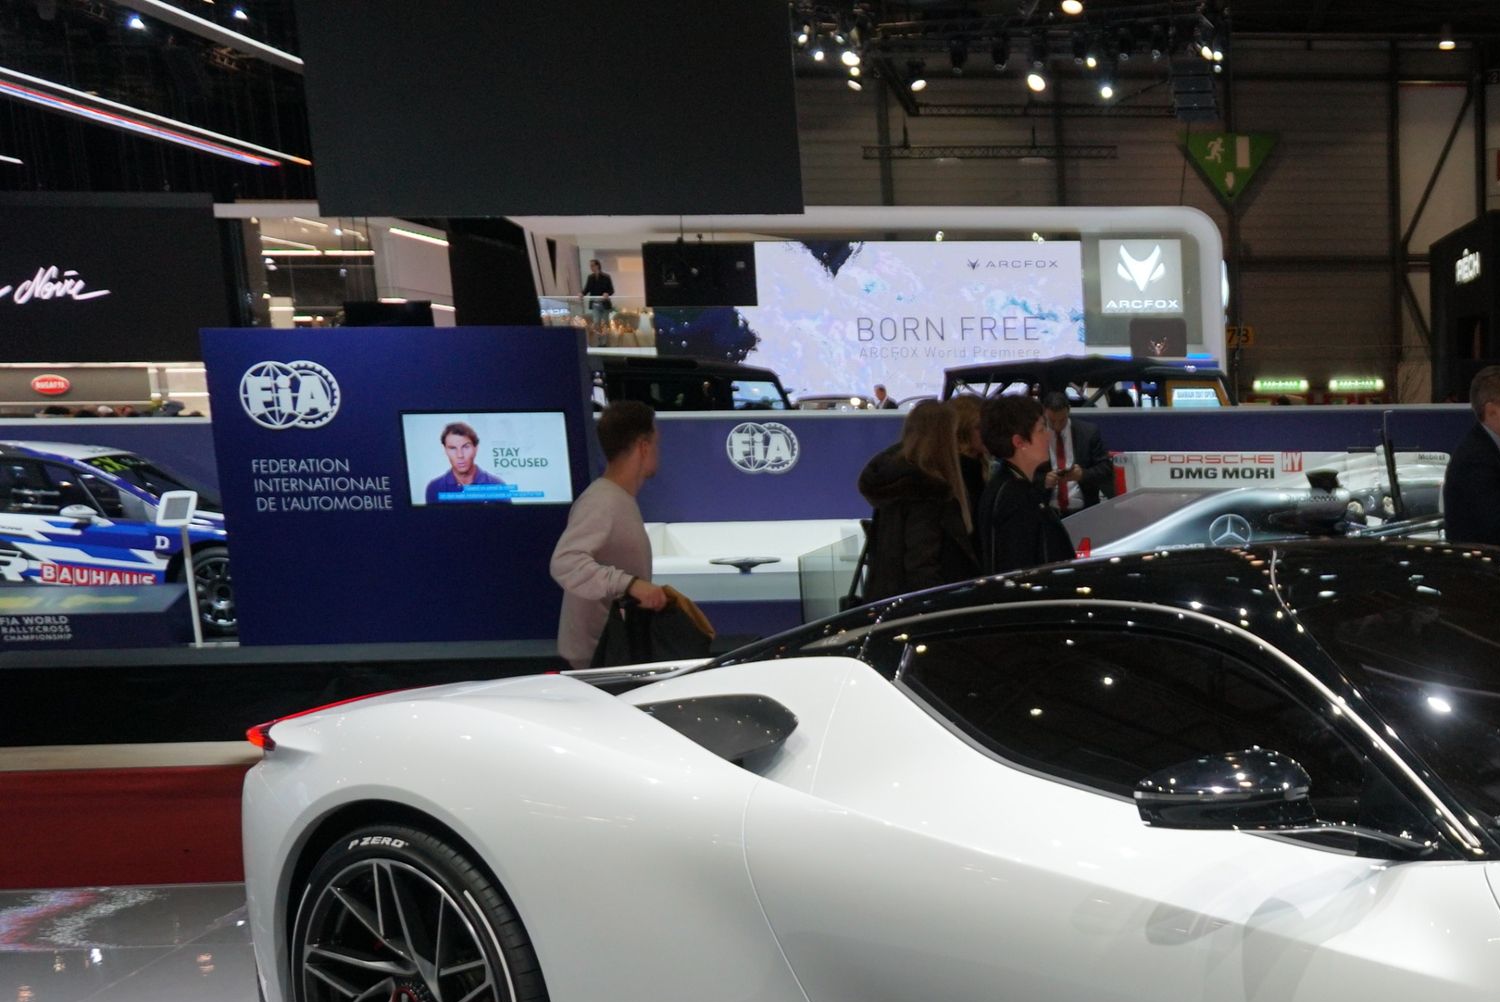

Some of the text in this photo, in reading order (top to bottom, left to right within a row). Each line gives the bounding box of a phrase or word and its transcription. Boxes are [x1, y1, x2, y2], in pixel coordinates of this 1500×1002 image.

[986, 259, 1058, 269] ARCFOX
[1106, 299, 1179, 309] ARCFOX
[857, 316, 1040, 342] BORN FREE
[859, 346, 1041, 359] ARCFOX World Premiere
[492, 448, 519, 457] STAY
[494, 458, 548, 468] FOCUSED
[1150, 454, 1275, 464] PORSCHE
[252, 459, 350, 474] FEDERATION
[1170, 467, 1275, 479] DMG MORI
[254, 477, 391, 493] INTERNATIONALE
[256, 496, 393, 512] DE L'AUTOMOBILE
[42, 564, 155, 585] BAUHAUS
[0, 615, 69, 625] FIA WORLD
[1, 625, 71, 633] RALLYCROSS
[348, 836, 405, 850] P ZERO
